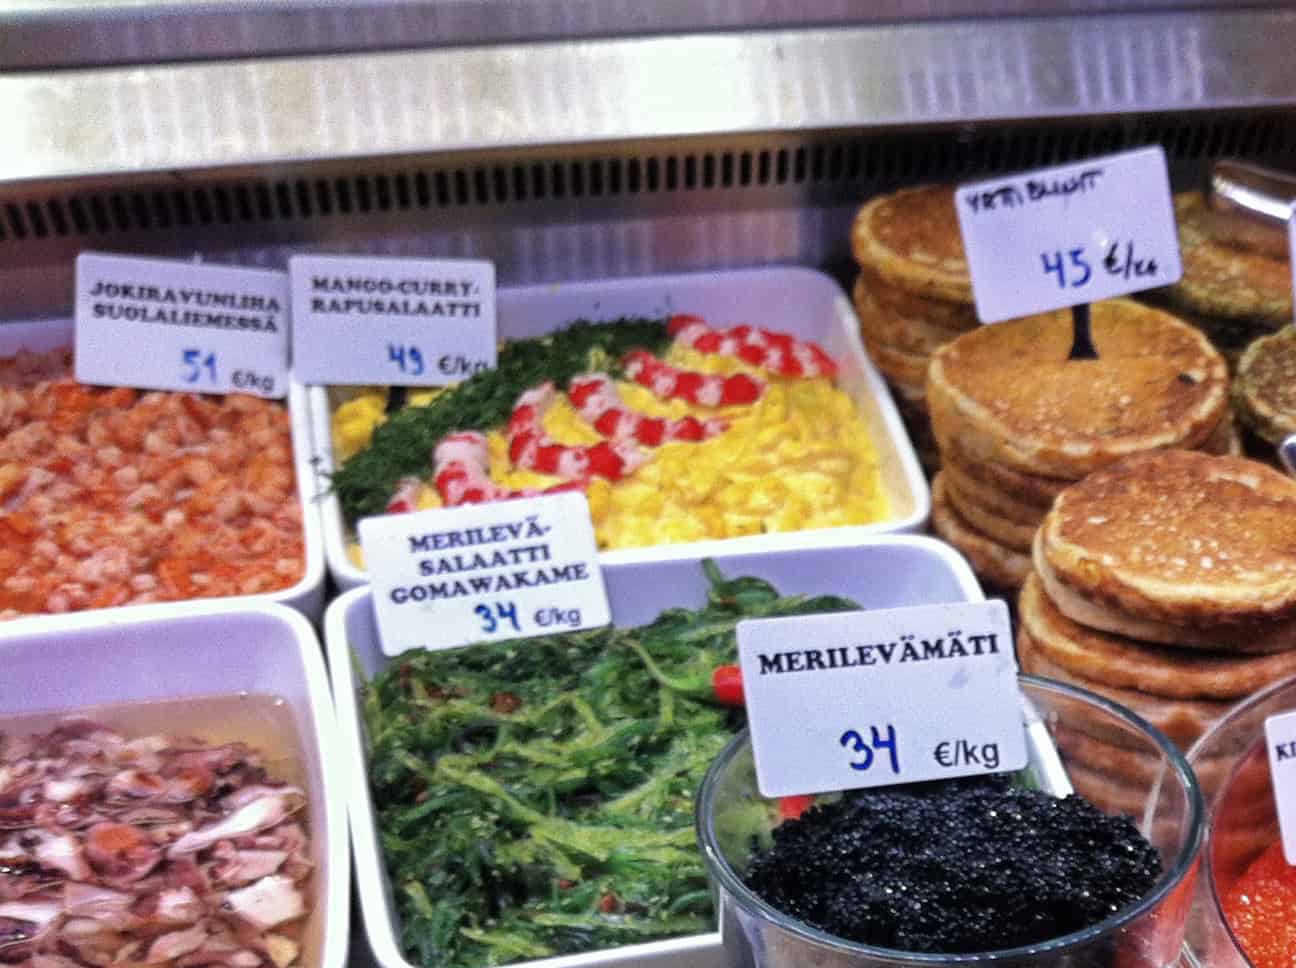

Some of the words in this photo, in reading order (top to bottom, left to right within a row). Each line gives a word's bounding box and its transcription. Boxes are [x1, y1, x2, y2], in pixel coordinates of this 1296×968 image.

[1041, 248, 1092, 288] 45
[90, 281, 281, 314] JOKIRAVUNLIHA
[311, 298, 482, 318] RAPUSALAATTI
[93, 303, 279, 334] SUOLALIEMESSÄ
[388, 344, 424, 376] 49
[231, 371, 275, 392] €/kg
[408, 515, 552, 553] MERILEVÄ-
[419, 544, 551, 577] SALAATTI
[390, 563, 590, 604] GOMAWAKAME
[474, 601, 521, 634] 34
[533, 608, 582, 627] €/kg
[757, 630, 1000, 675] MERILEVÄMÄTI
[839, 724, 900, 774] 34
[933, 739, 1000, 769] €/kg
